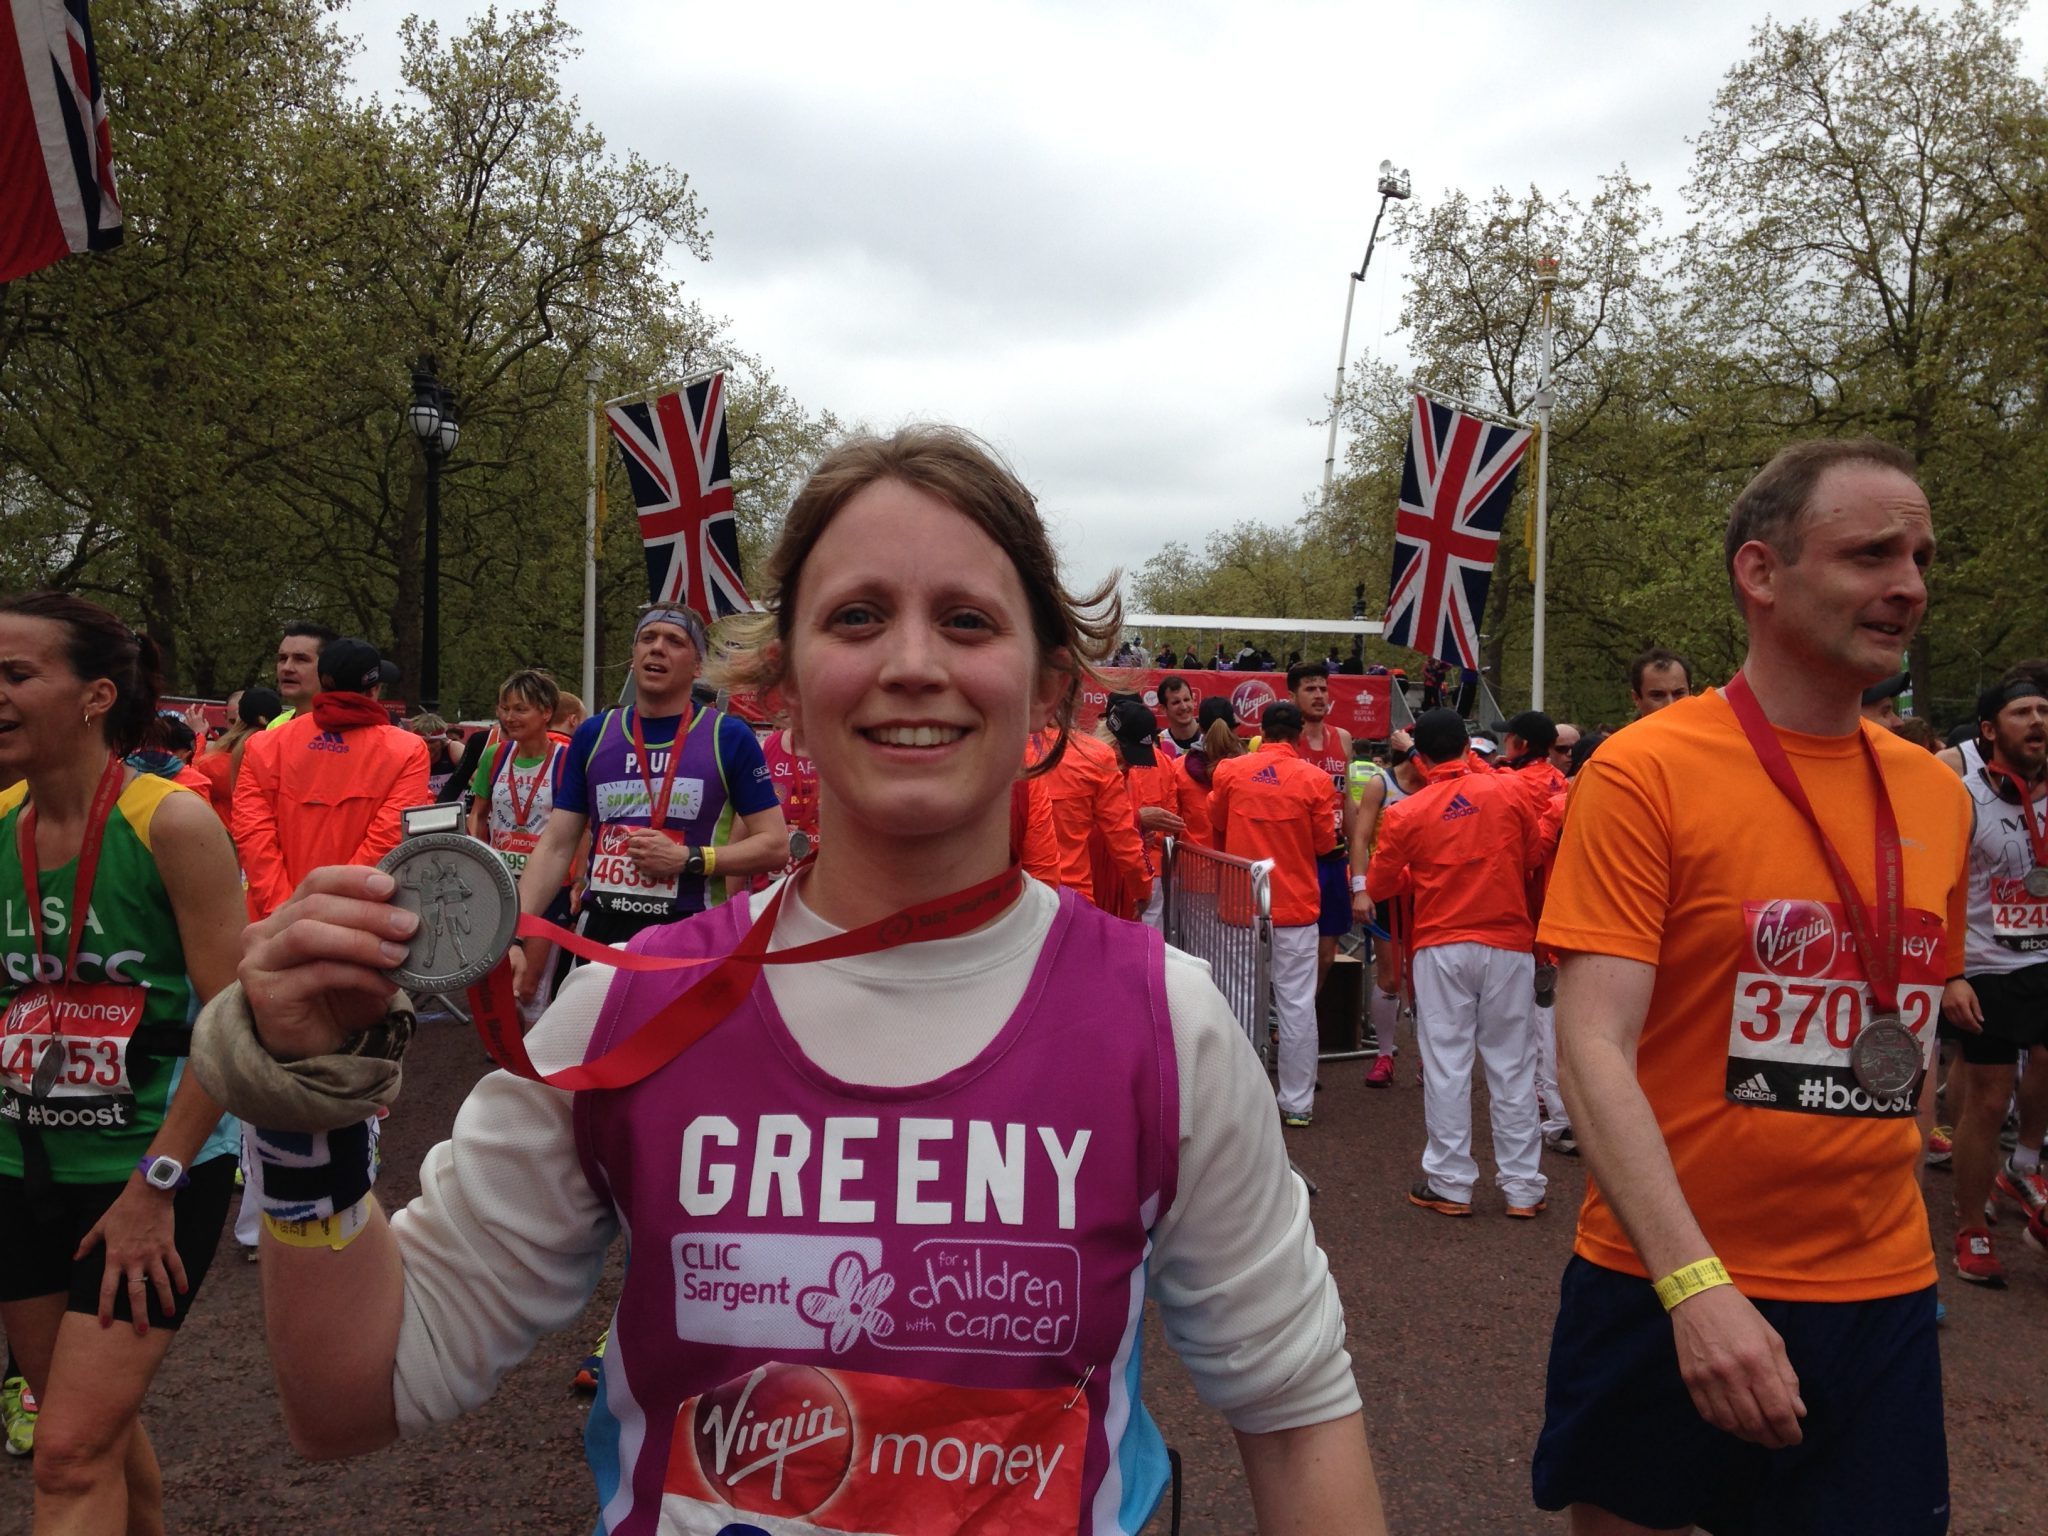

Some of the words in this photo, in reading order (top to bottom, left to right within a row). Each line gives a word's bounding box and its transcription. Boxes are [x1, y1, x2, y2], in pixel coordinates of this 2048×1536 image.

[1236, 687, 1273, 719] Virgin
[307, 740, 350, 753] adidas
[1250, 776, 1280, 785] adidas
[1441, 805, 1480, 821] adidas
[610, 897, 669, 915] #boost
[1761, 902, 1831, 969] Virgin
[56, 1001, 136, 1026] money
[1732, 1087, 1777, 1103] adidas
[27, 1102, 127, 1127] #boost
[678, 1114, 1093, 1230] GREENY
[682, 1242, 742, 1271] CLIC
[938, 1251, 960, 1267] for
[683, 1272, 790, 1311] Sargent
[908, 1249, 1063, 1309] children
[905, 1314, 936, 1333] with
[945, 1309, 1072, 1345] cancer
[702, 1366, 847, 1501] Virgin
[869, 1431, 1065, 1500] money
